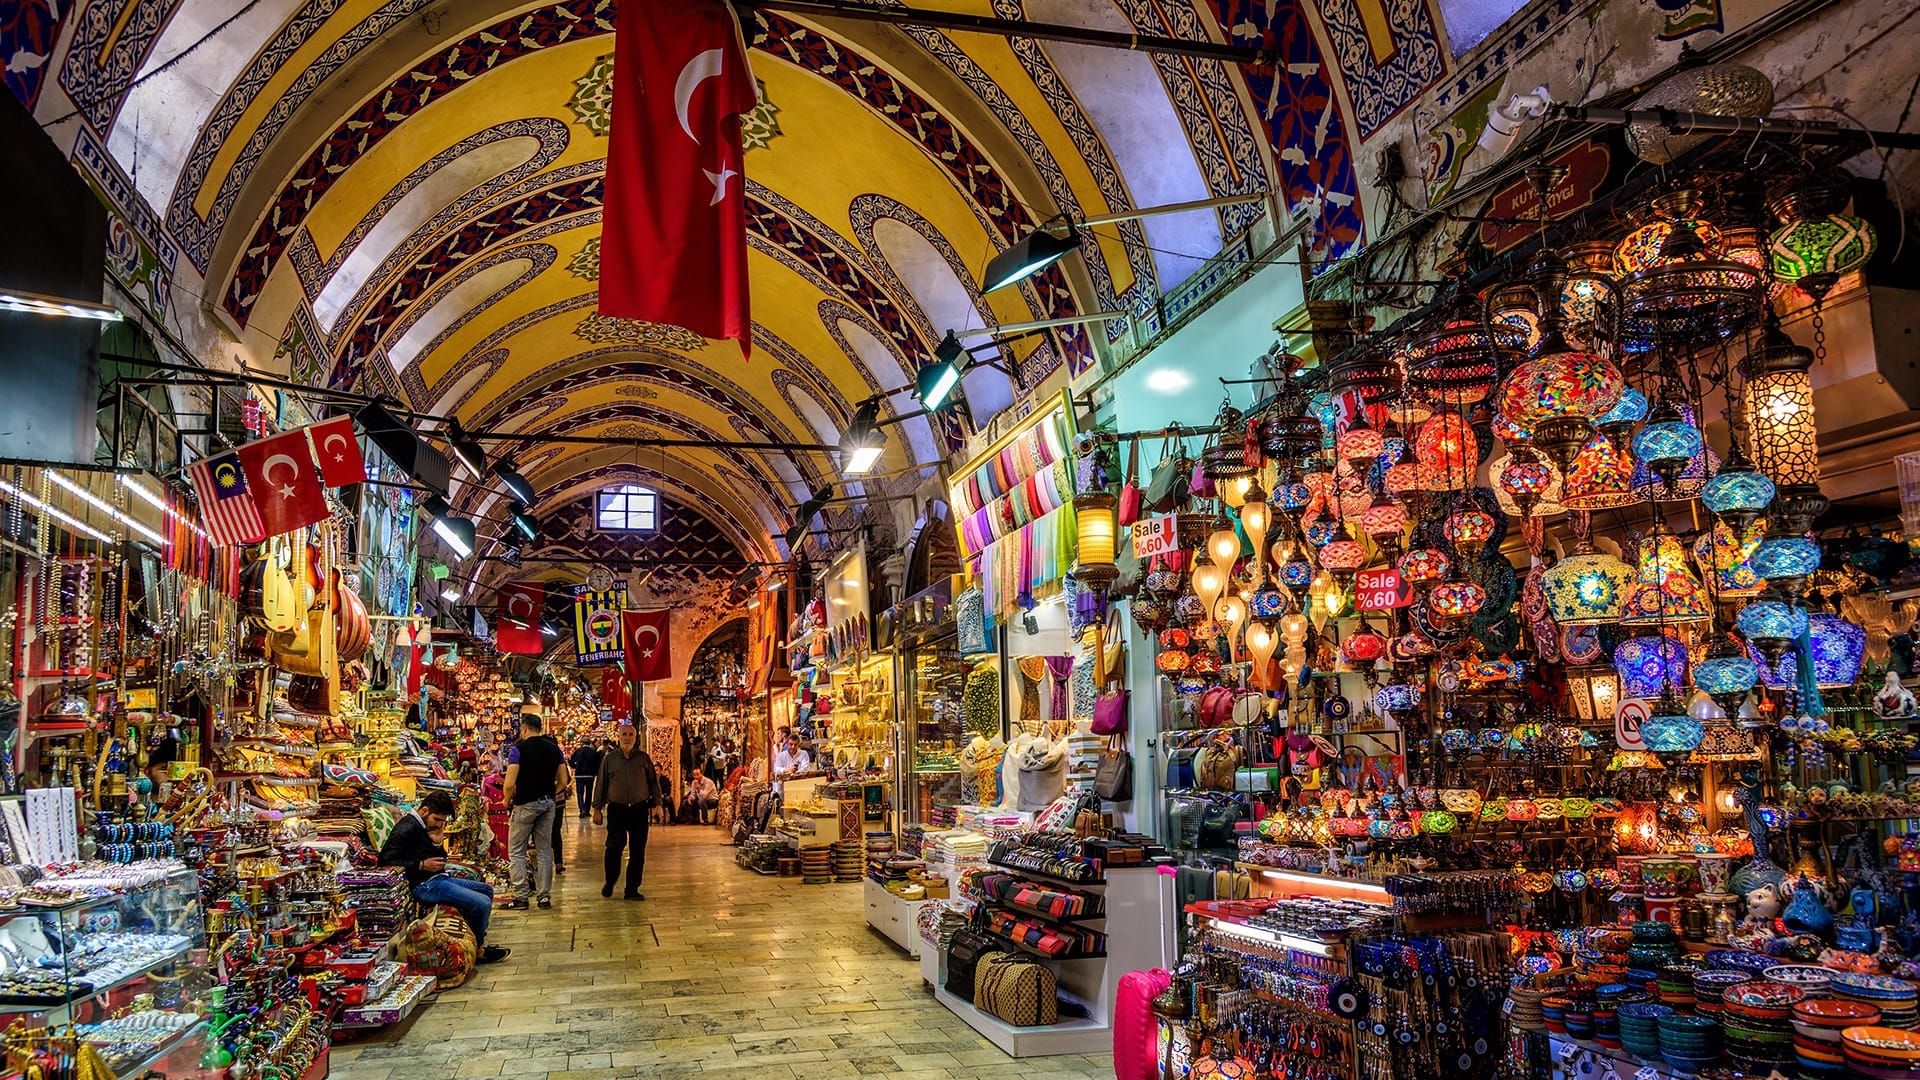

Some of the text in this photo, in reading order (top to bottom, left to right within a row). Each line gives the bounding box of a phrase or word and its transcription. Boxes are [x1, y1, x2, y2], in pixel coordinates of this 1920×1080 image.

[1134, 521, 1161, 538] Sale
[1134, 537, 1162, 556] %60
[1358, 573, 1396, 589] Sale
[1357, 590, 1396, 609] %60
[580, 650, 625, 663] FENERBAHÇ
